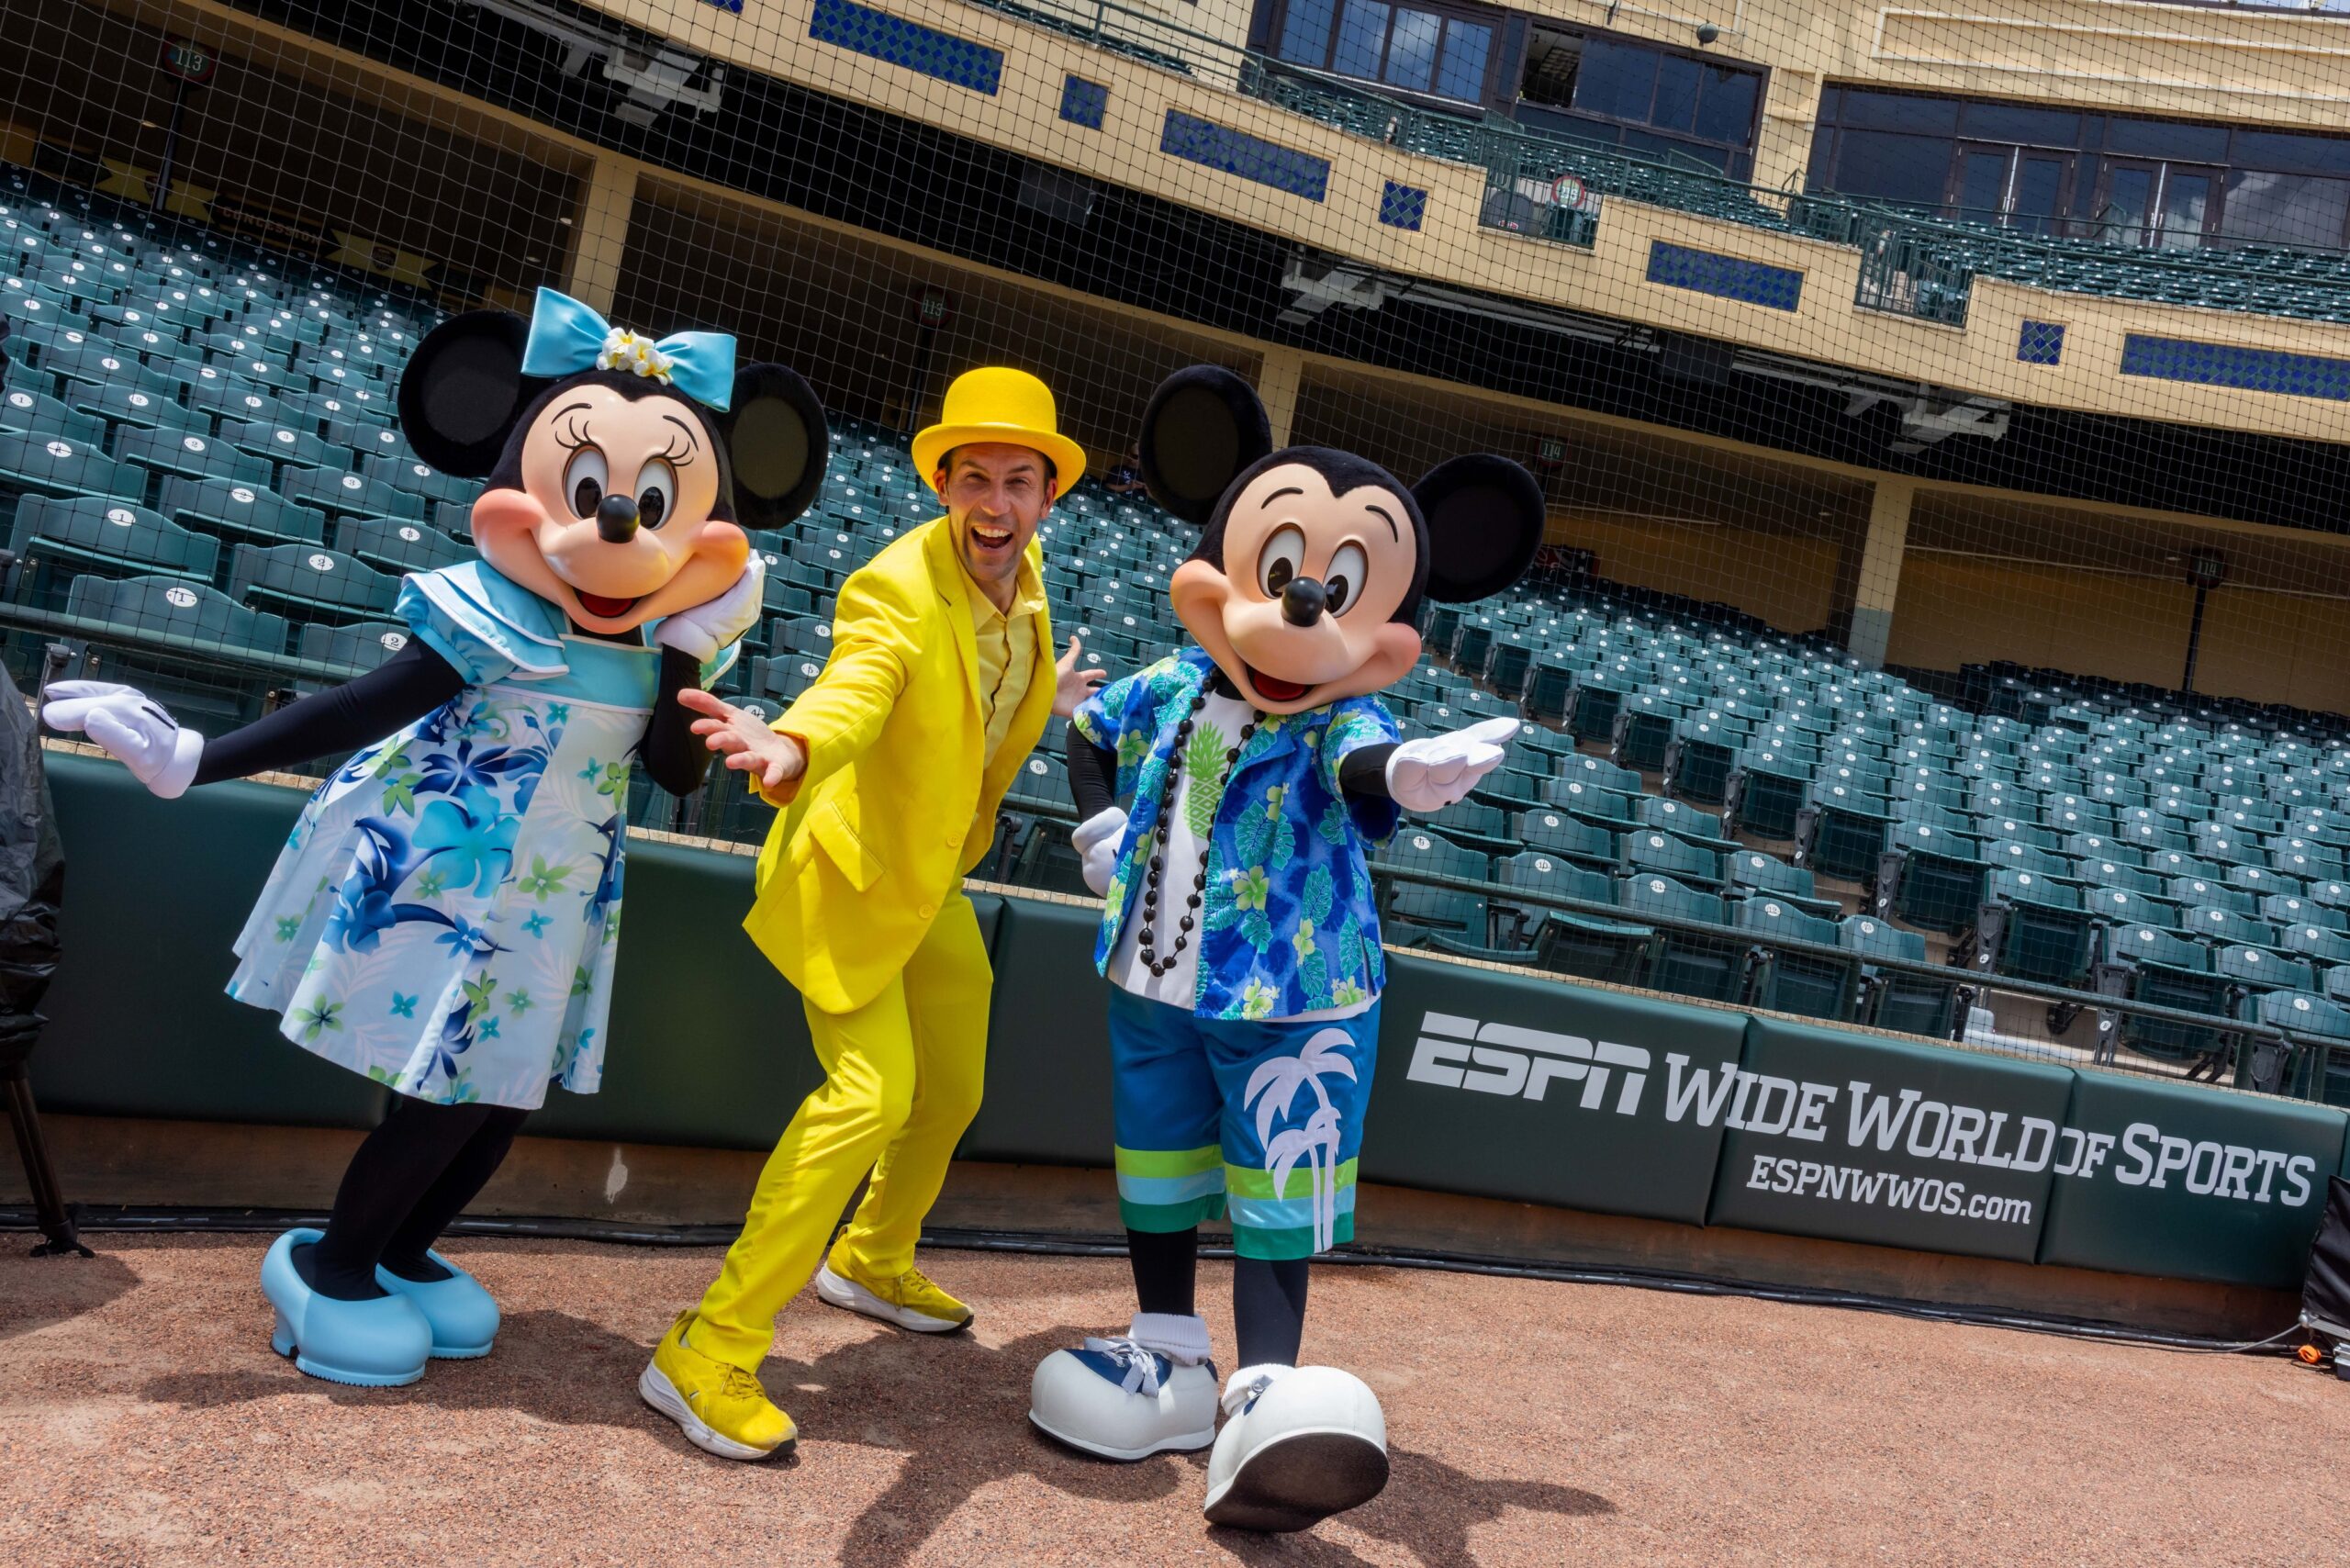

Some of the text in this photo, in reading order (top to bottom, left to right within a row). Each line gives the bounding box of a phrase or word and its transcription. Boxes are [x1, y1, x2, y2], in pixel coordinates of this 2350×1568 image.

[176, 48, 203, 72] 113
[318, 558, 326, 566] 2
[179, 592, 185, 603] 1
[391, 637, 399, 646] 2
[1406, 1011, 1651, 1116] ESPN
[1664, 1051, 1839, 1142] WIDE
[1847, 1080, 2057, 1173] WORLD
[2115, 1122, 2316, 1207] SPORTS
[1746, 1154, 2032, 1225] ESPNWWOS.com
